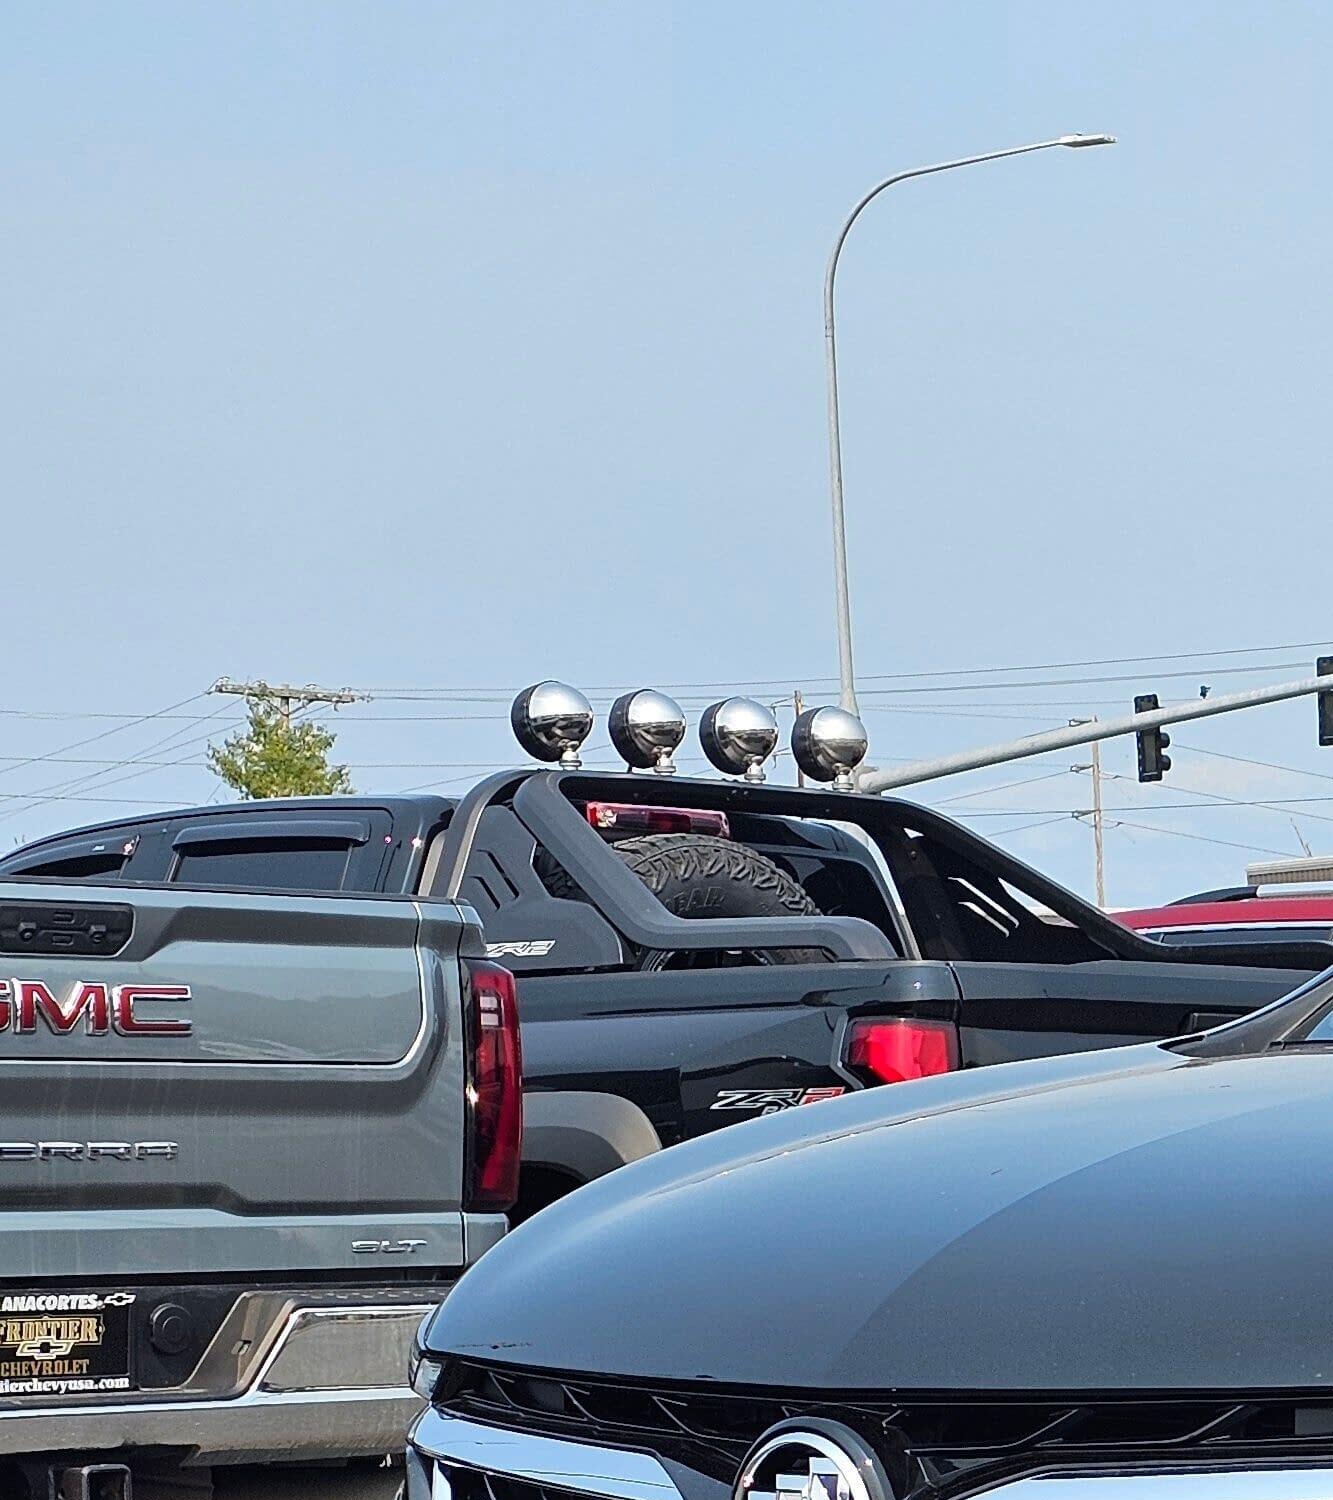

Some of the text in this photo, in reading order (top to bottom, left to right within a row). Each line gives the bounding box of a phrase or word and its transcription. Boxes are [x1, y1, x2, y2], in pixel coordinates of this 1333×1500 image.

[0, 978, 193, 1037] MC
[351, 1239, 427, 1254] SLT
[2, 1294, 98, 1312] ANACORTES
[0, 1359, 90, 1377] CHEVROLET
